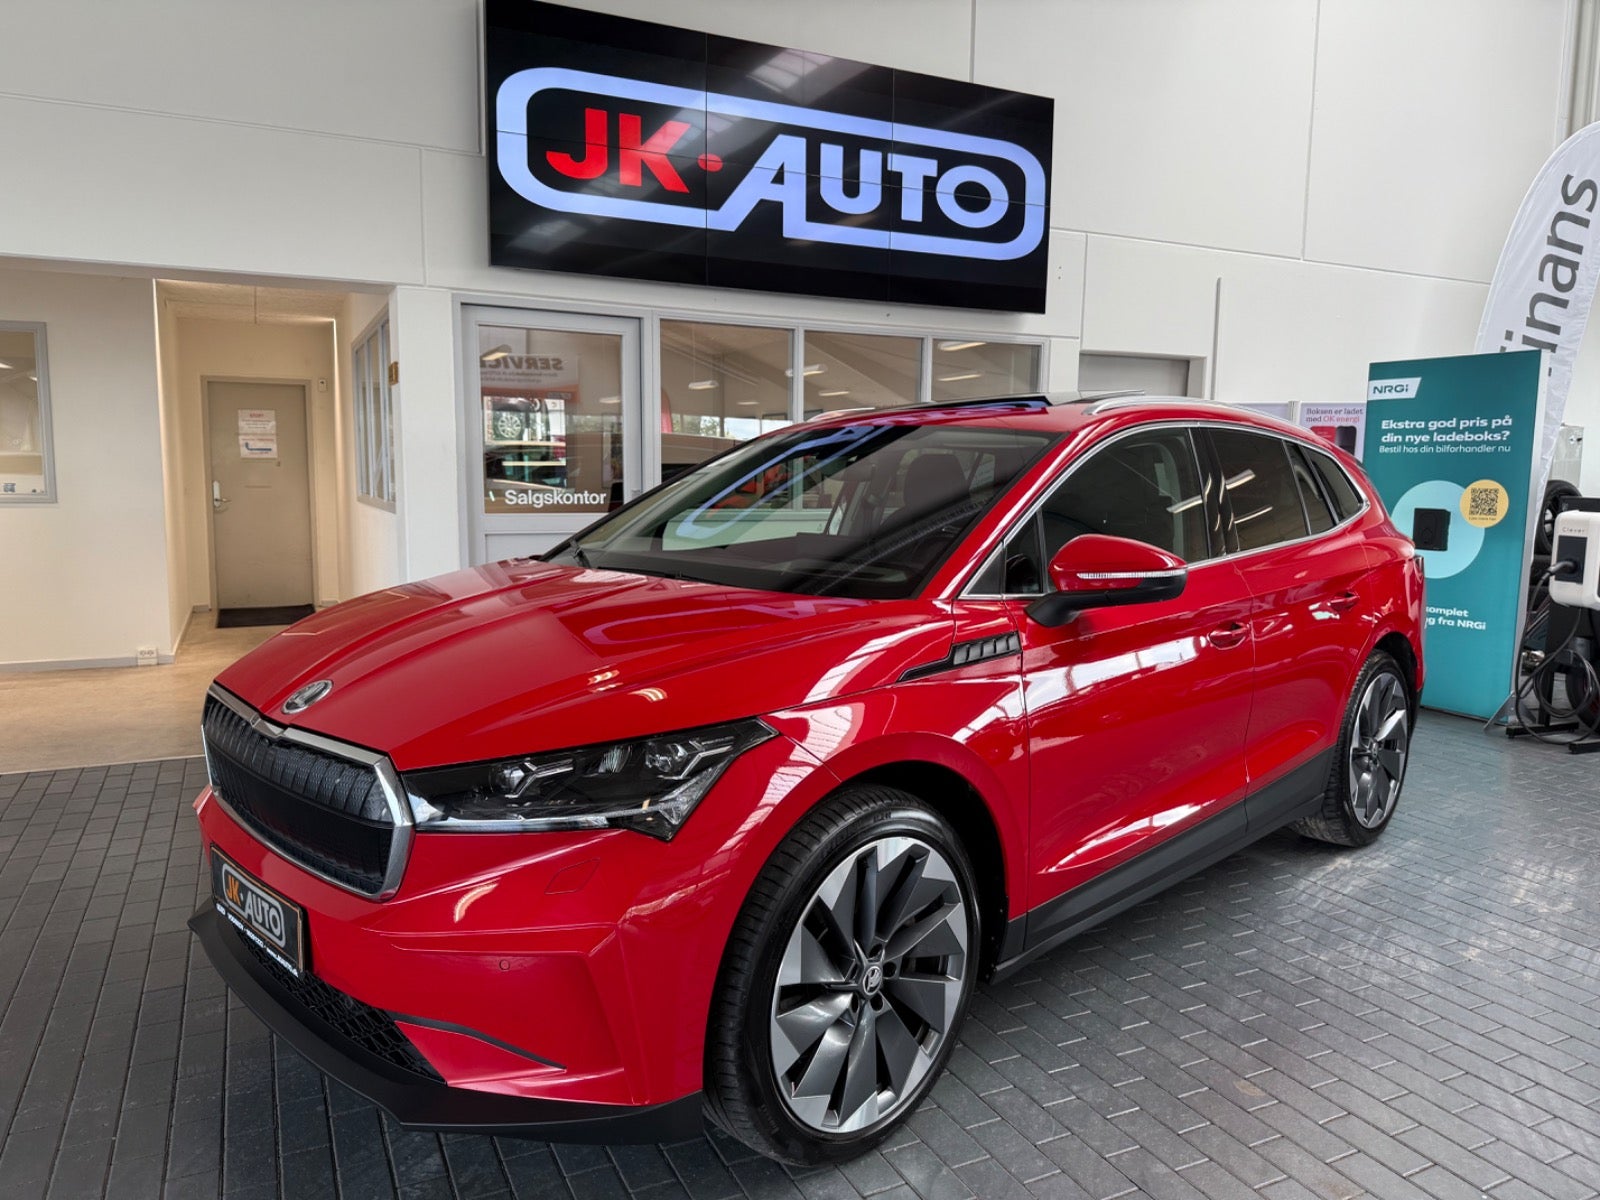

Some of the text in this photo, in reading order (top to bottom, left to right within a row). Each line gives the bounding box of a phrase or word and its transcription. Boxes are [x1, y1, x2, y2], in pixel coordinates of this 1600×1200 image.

[1500, 173, 1598, 376] inans
[1381, 414, 1513, 431] Ekstra god pris på
[1381, 430, 1511, 446] din nye ladeboks?
[1379, 445, 1402, 453] Bestil
[1403, 445, 1419, 453] hos
[1420, 445, 1434, 453] din
[1436, 444, 1497, 453] bilforhandler
[504, 489, 607, 509] Salgskontor
[1426, 606, 1469, 617] omplet
[1437, 616, 1455, 626] fra
[1457, 619, 1486, 630] NRGi
